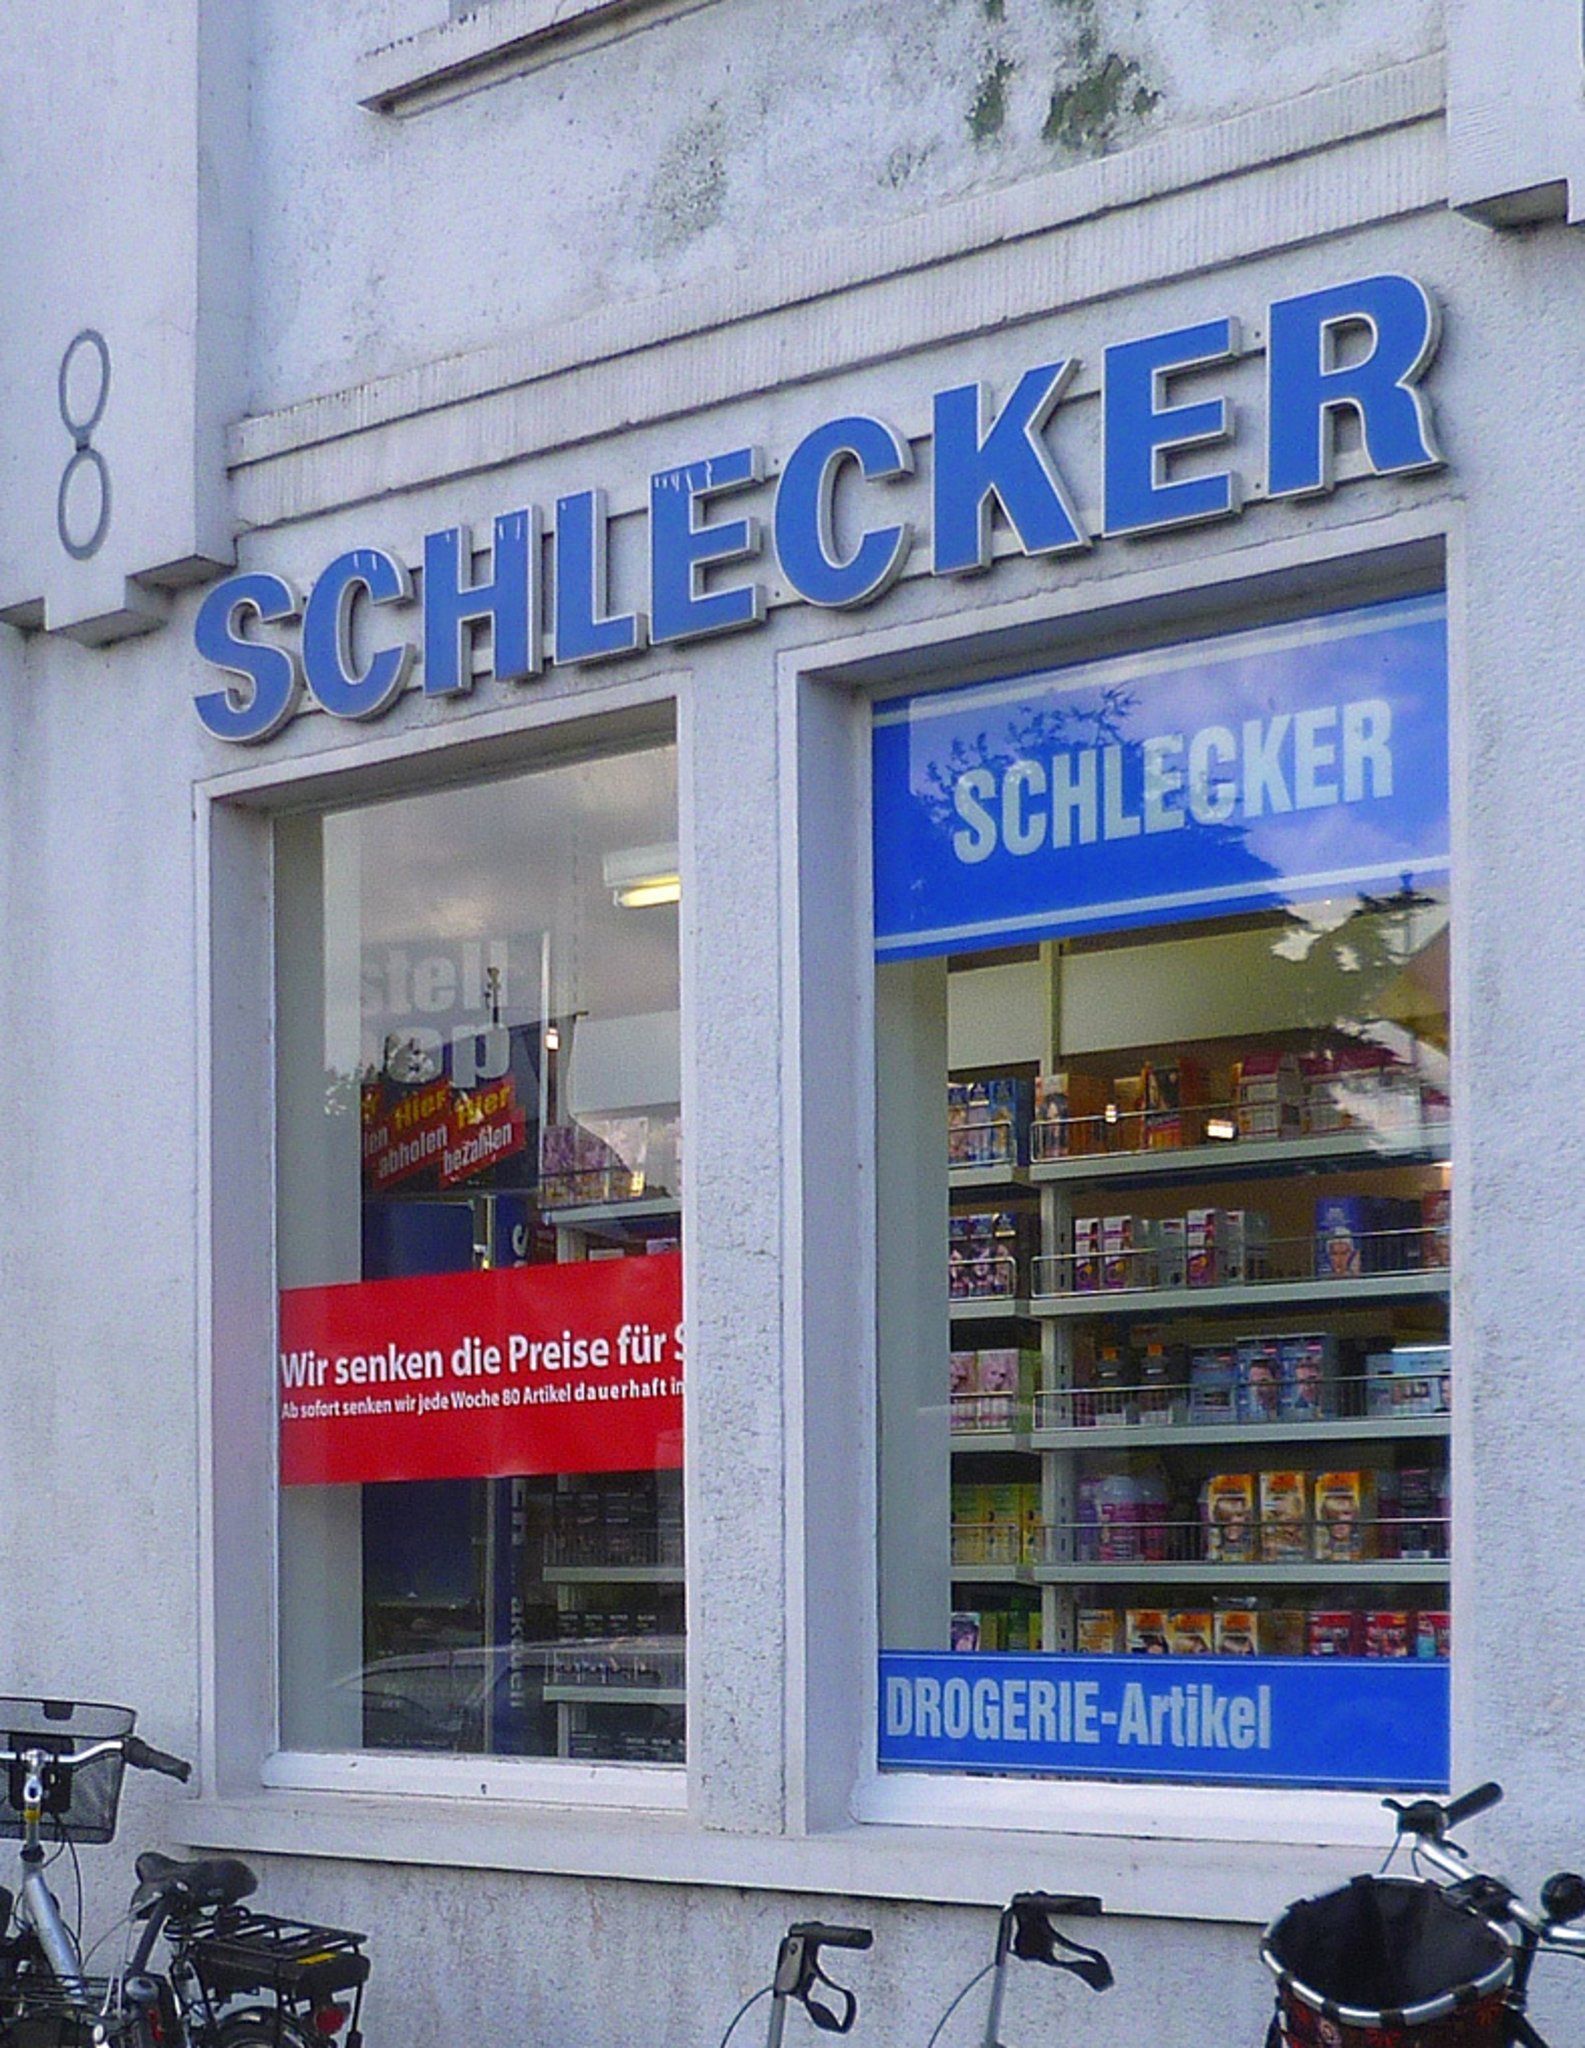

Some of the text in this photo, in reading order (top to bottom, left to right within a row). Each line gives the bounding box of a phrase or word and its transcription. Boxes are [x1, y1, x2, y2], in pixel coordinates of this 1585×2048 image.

[194, 273, 1447, 746] SCHLECKER
[952, 699, 1394, 864] SCHLECKER
[280, 1350, 328, 1388] Wir
[335, 1342, 443, 1385] senken
[451, 1336, 501, 1376] die
[508, 1329, 609, 1373] Preise
[617, 1323, 667, 1365] für
[281, 1402, 298, 1419] Ab
[301, 1398, 341, 1418] sofort
[343, 1395, 392, 1415] senken
[394, 1393, 416, 1412] wir
[417, 1389, 449, 1415] jede
[451, 1388, 499, 1409] Woche
[502, 1387, 520, 1406] 80
[523, 1383, 571, 1405] Artikel
[574, 1377, 667, 1401] dauerhaft
[886, 1676, 1272, 1750] DROGERIE-Artikel
